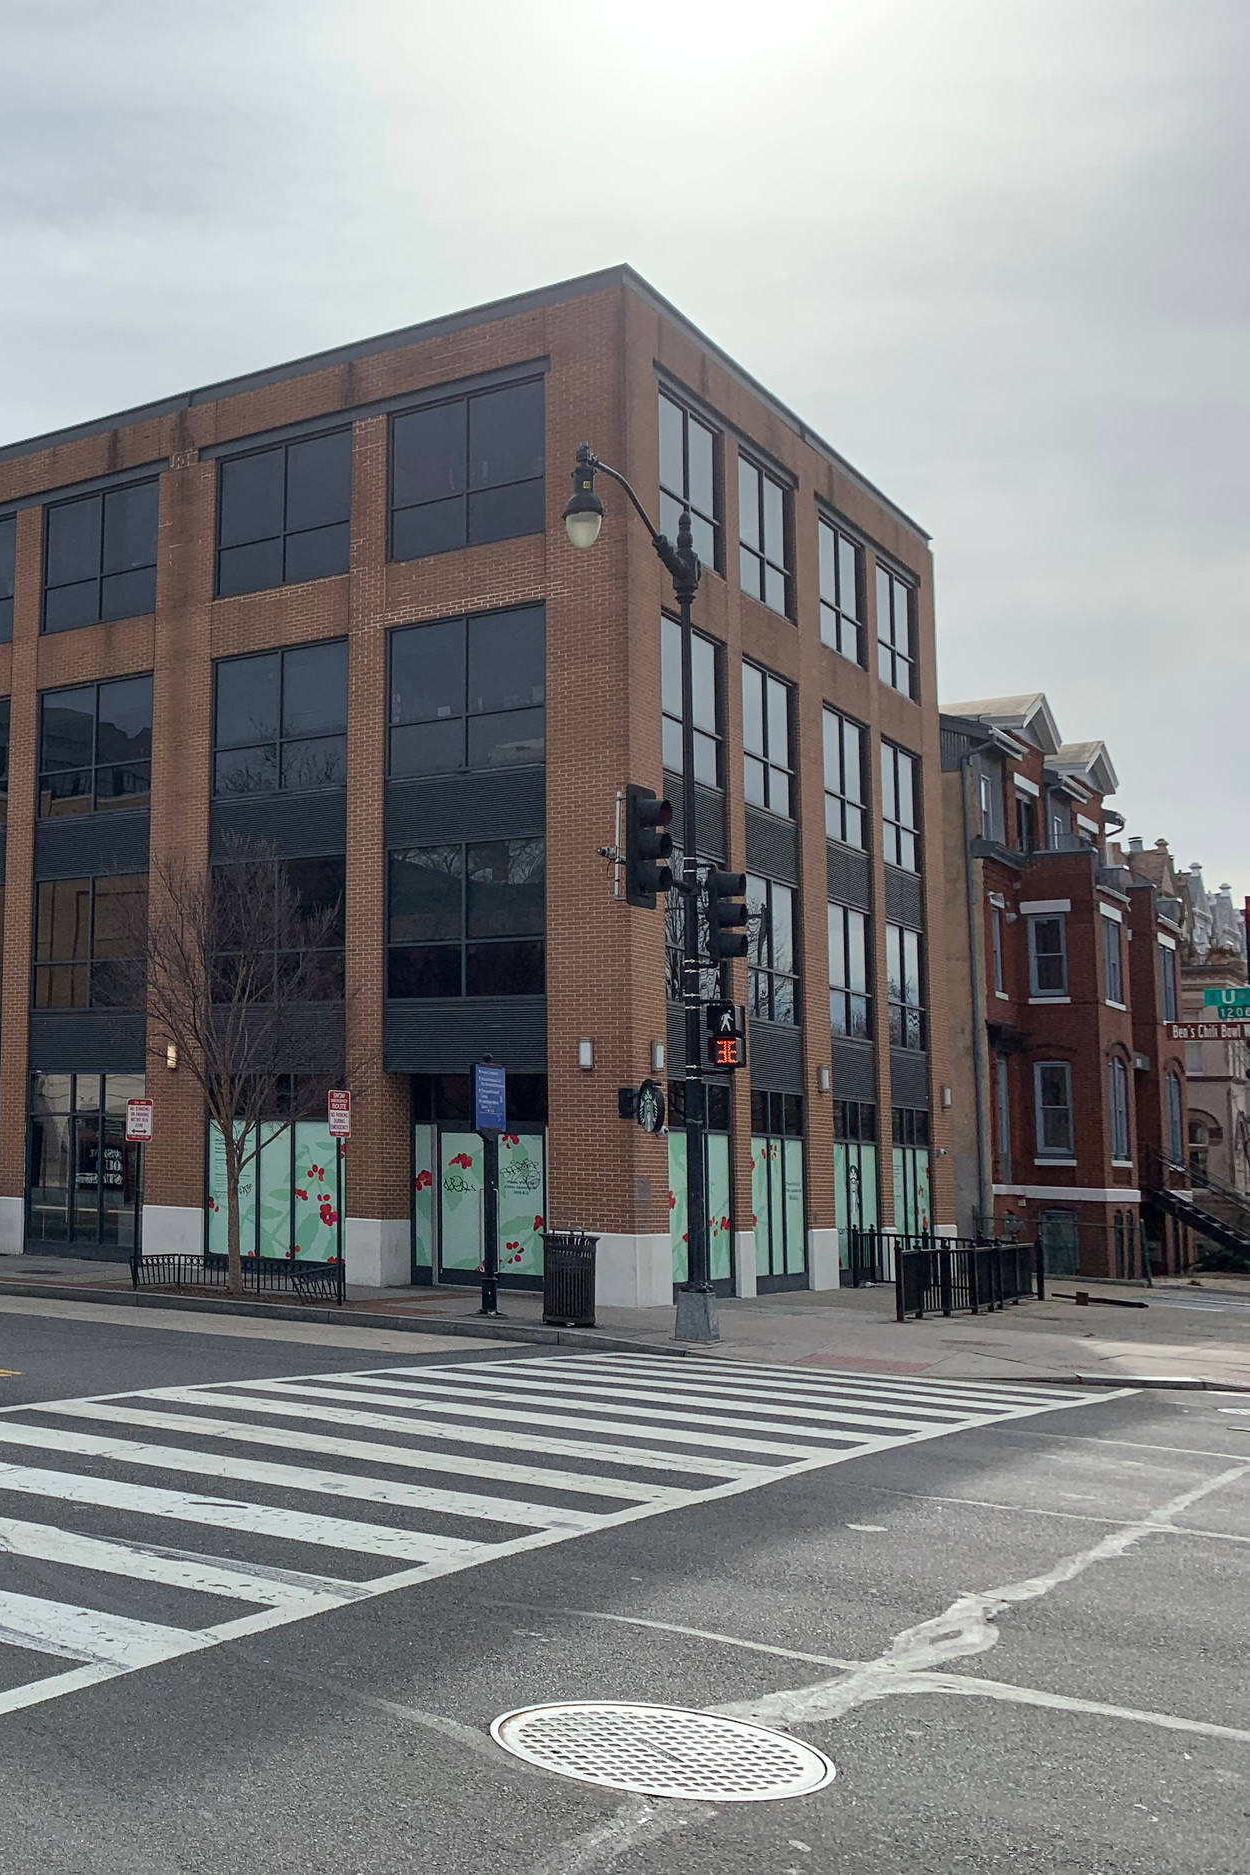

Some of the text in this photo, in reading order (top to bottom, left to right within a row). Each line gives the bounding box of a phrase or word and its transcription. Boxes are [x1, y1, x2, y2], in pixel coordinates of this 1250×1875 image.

[1221, 990, 1236, 1004] U
[1172, 1024, 1196, 1039] Ben's
[1198, 1024, 1218, 1038] Chili
[1221, 1024, 1241, 1038] Bowl
